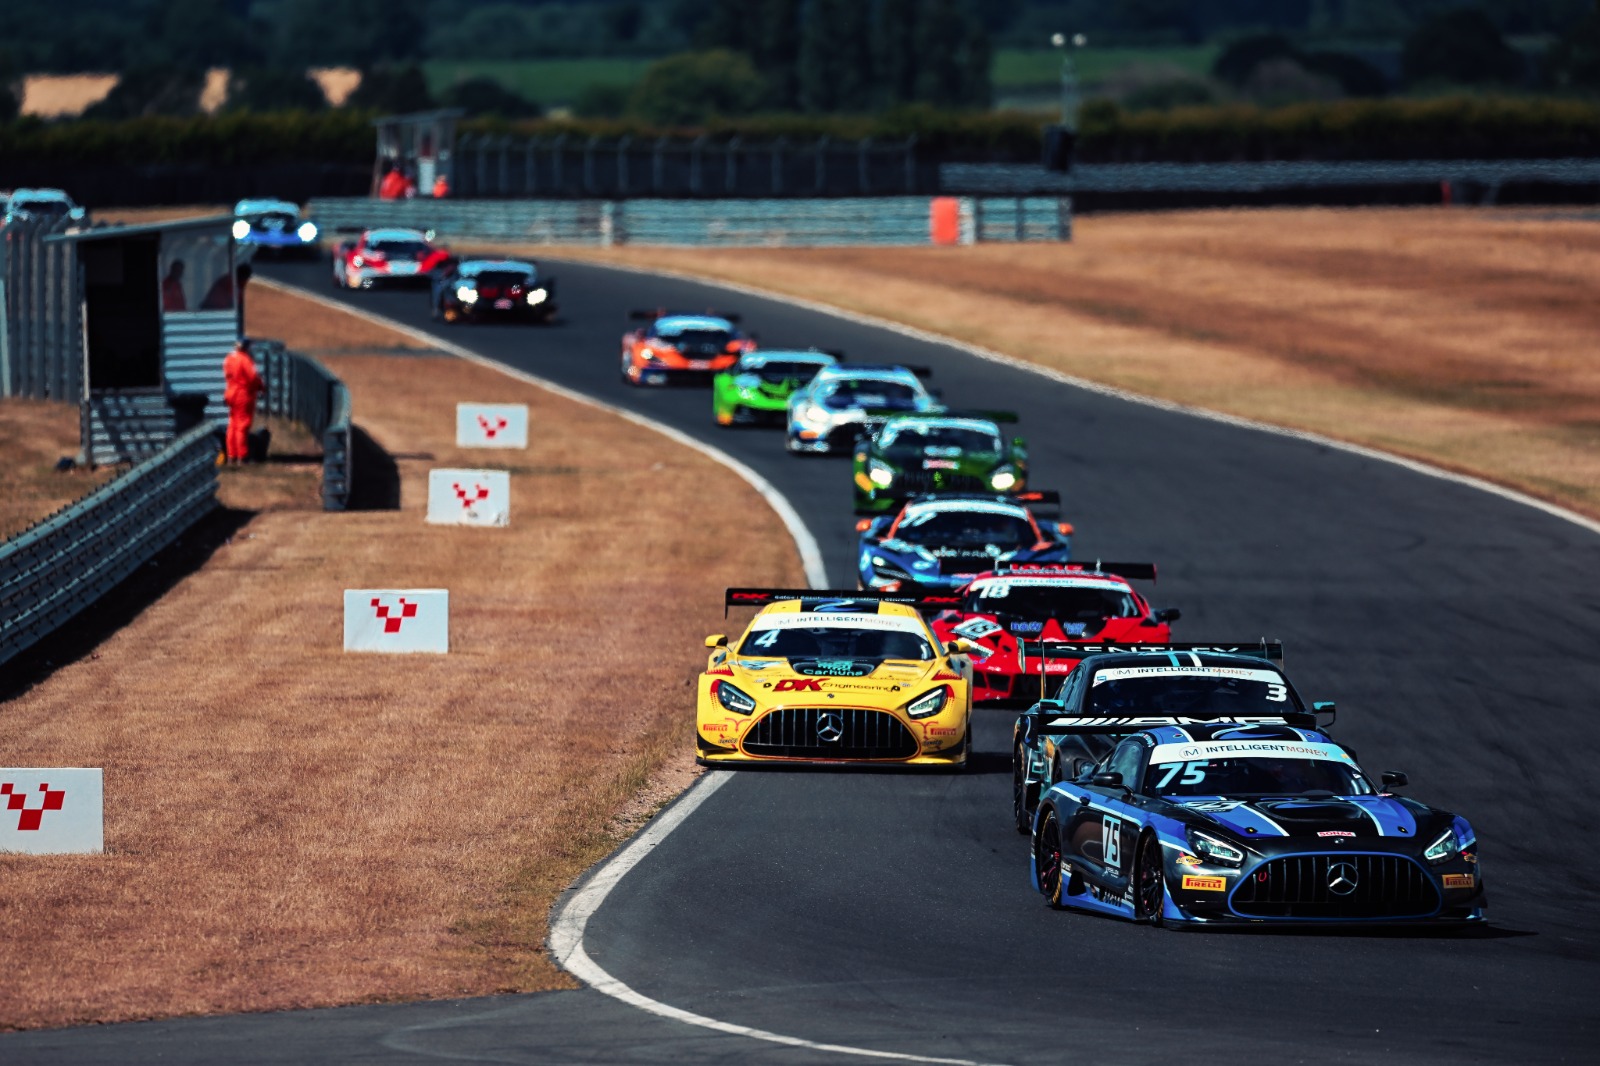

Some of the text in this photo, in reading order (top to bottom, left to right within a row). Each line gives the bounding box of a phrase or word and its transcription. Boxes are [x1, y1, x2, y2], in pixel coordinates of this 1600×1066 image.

[980, 583, 1011, 598] 18
[754, 629, 780, 648] 4
[772, 678, 894, 693] DK Engineering
[1265, 683, 1287, 702] 3
[703, 723, 728, 731] PIRELLI
[930, 727, 957, 736] PIRELLI
[1155, 761, 1209, 789] 75
[1104, 819, 1120, 863] 75
[1185, 877, 1223, 889] PIRELLI
[1445, 877, 1473, 886] PIRELLI
